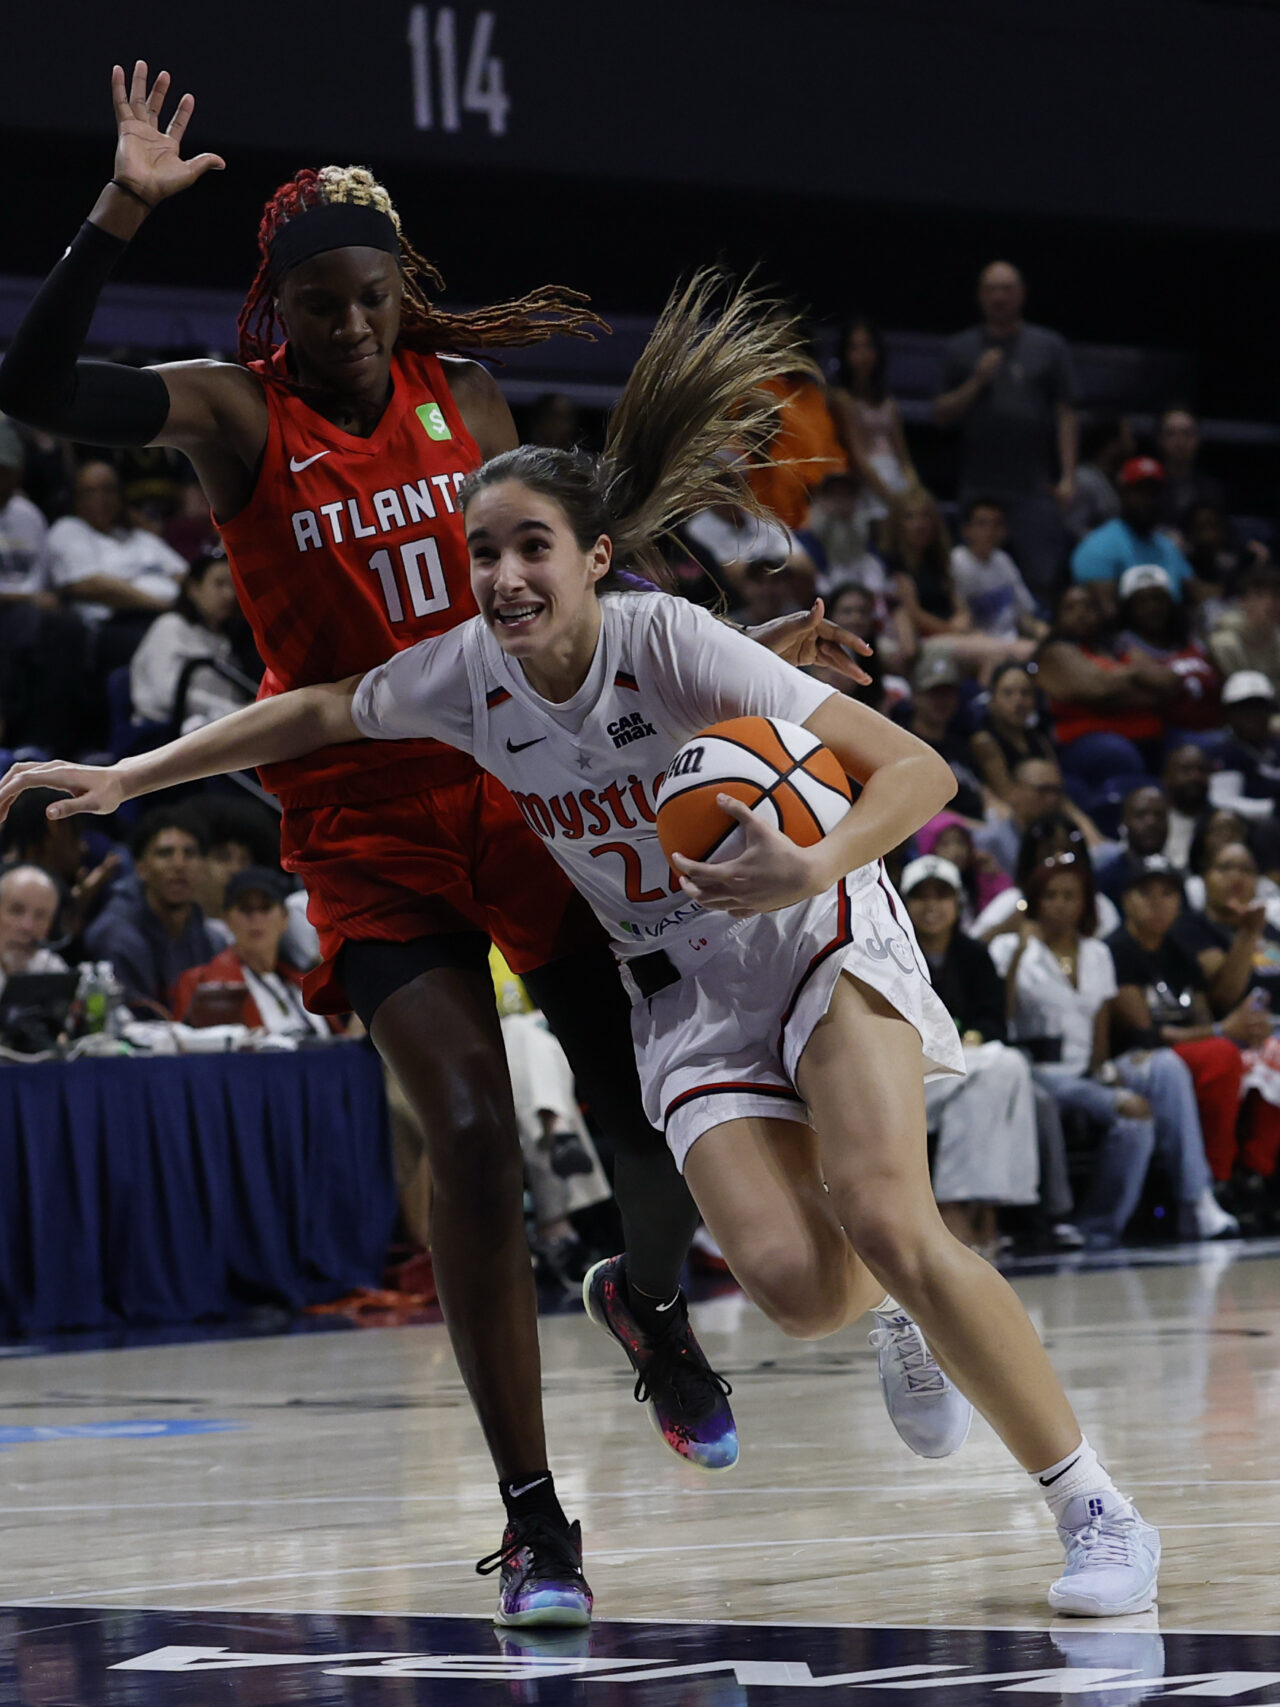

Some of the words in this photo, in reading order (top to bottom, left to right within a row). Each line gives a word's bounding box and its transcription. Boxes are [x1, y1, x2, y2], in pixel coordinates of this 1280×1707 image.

[406, 3, 510, 137] 114
[368, 536, 451, 623] 10
[607, 711, 644, 737] CAR
[612, 722, 658, 749] max
[589, 842, 692, 902] 2
